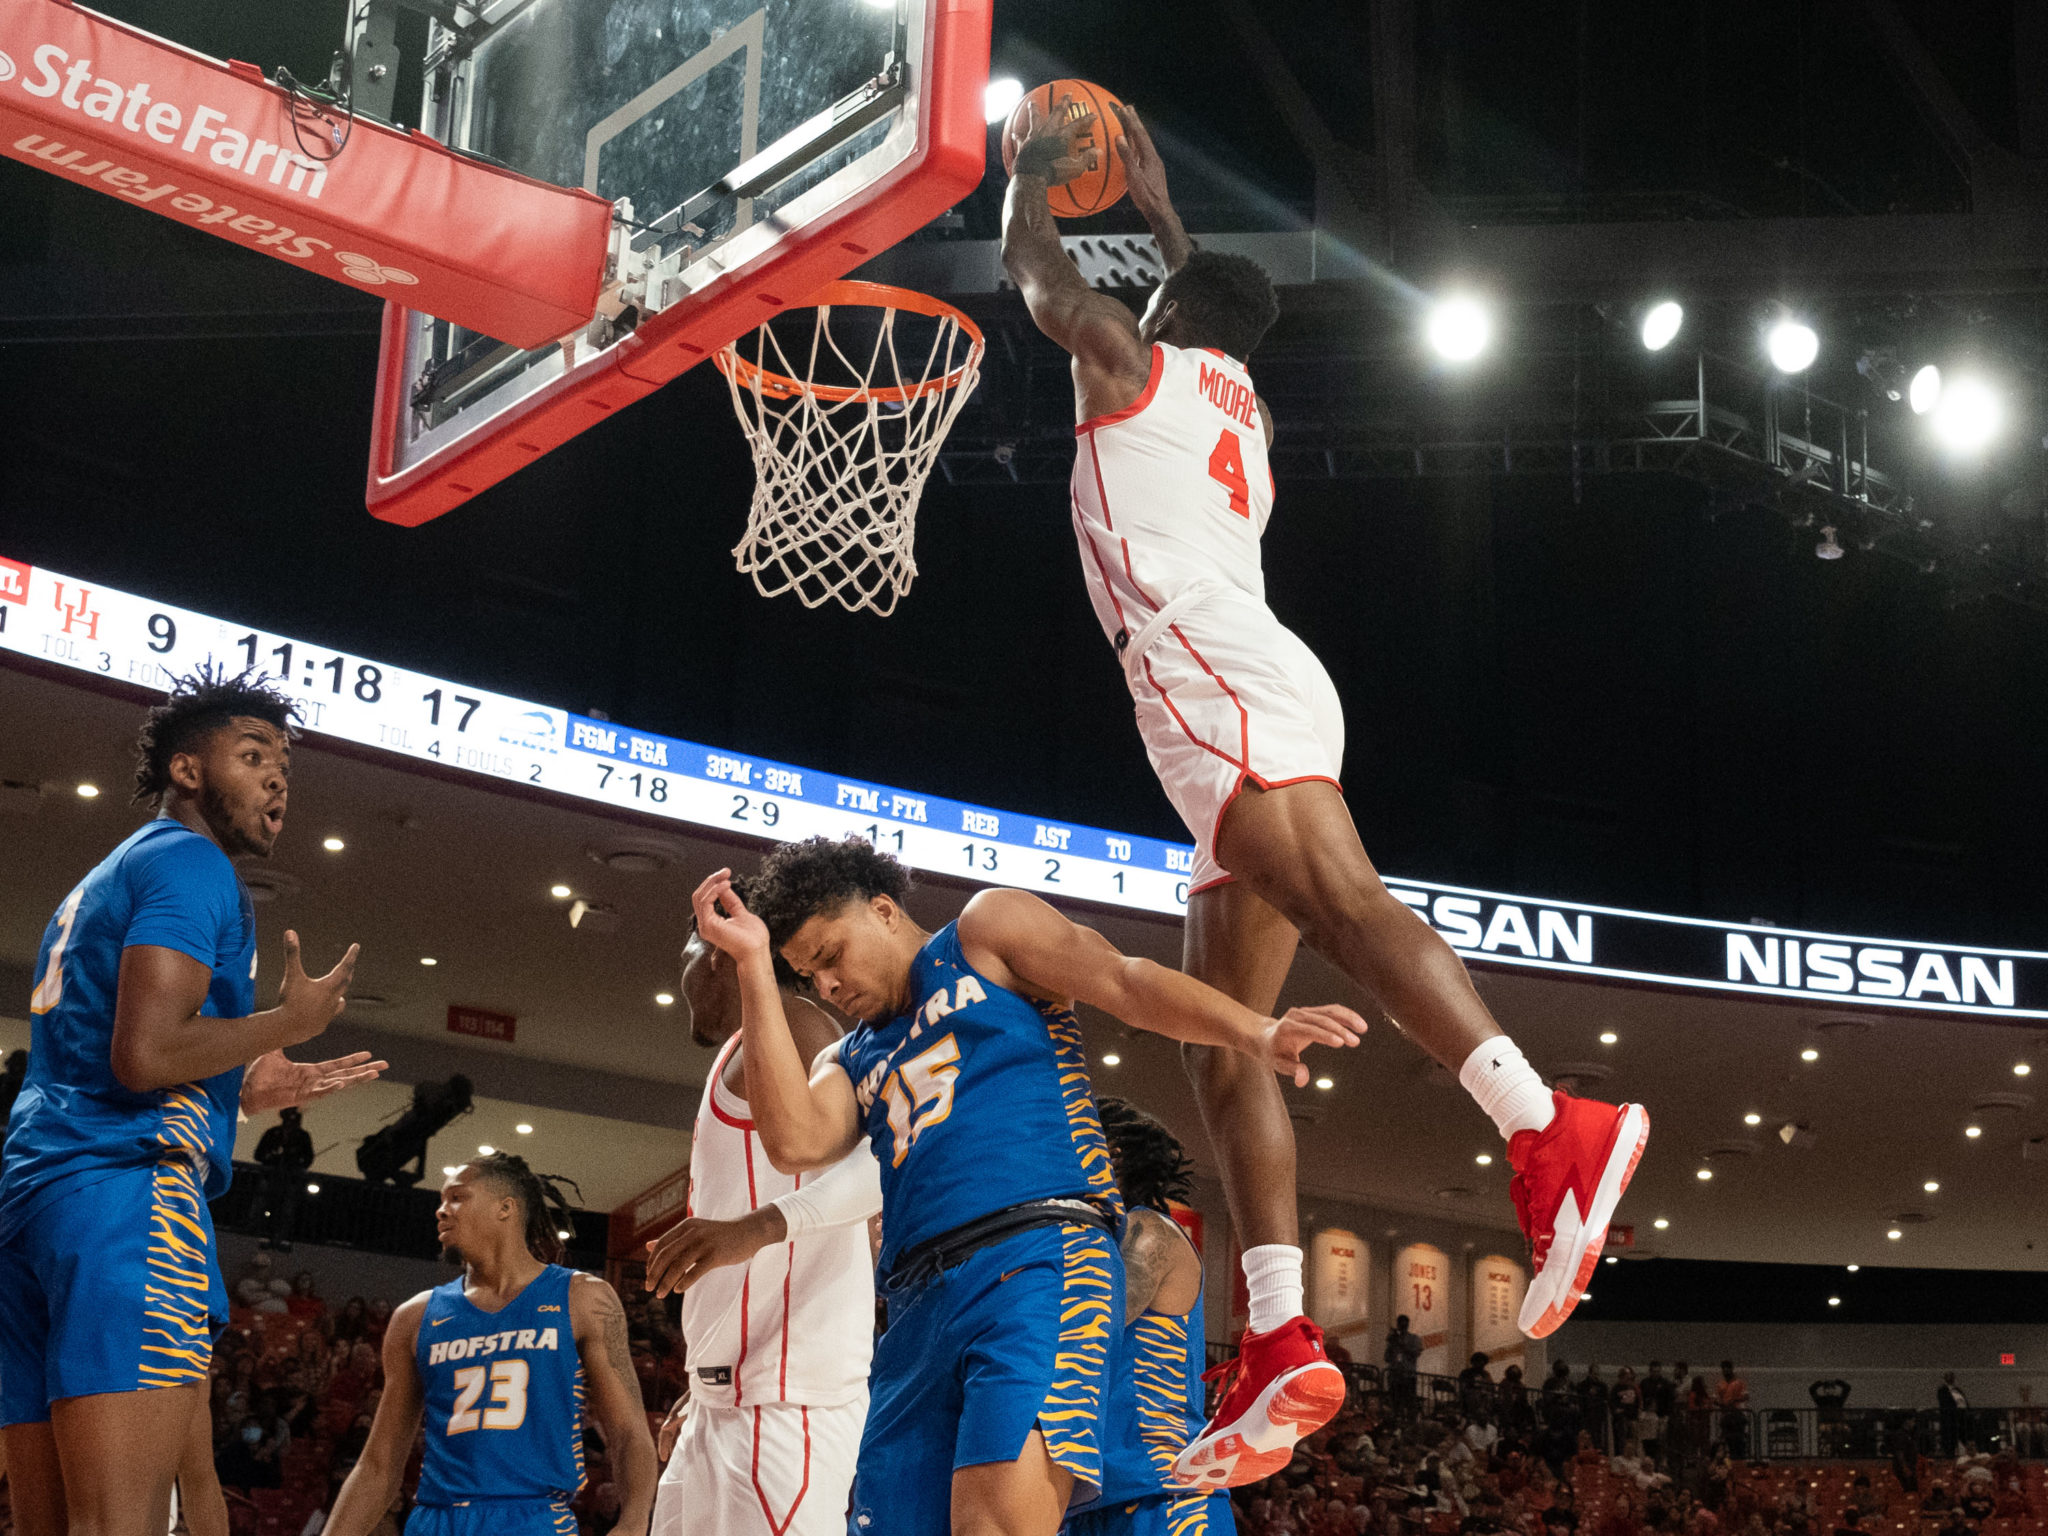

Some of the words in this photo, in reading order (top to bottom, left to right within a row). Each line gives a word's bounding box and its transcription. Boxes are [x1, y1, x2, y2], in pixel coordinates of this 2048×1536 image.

[1199, 361, 1257, 430] MOORE
[1208, 428, 1250, 520] 4
[147, 613, 177, 654] 9
[237, 633, 382, 703] 11:18
[422, 688, 481, 733] 17
[97, 651, 111, 672] 3
[427, 740, 441, 758] 4
[529, 763, 543, 783] 2
[596, 763, 668, 803] 7-18
[731, 794, 780, 827] 2-9
[963, 843, 998, 871] 13
[1044, 859, 1061, 883] 2
[1112, 871, 1125, 894] 1
[962, 810, 999, 838] REB
[1034, 824, 1072, 851] AST
[1106, 838, 1131, 861] TO
[1727, 933, 2014, 1007] NISSAN
[879, 1032, 961, 1169] 15
[537, 1304, 561, 1312] CAA
[1409, 1263, 1437, 1281] JONES
[1413, 1284, 1432, 1311] 13
[429, 1328, 558, 1366] HOFSTRA
[447, 1359, 530, 1436] 23
